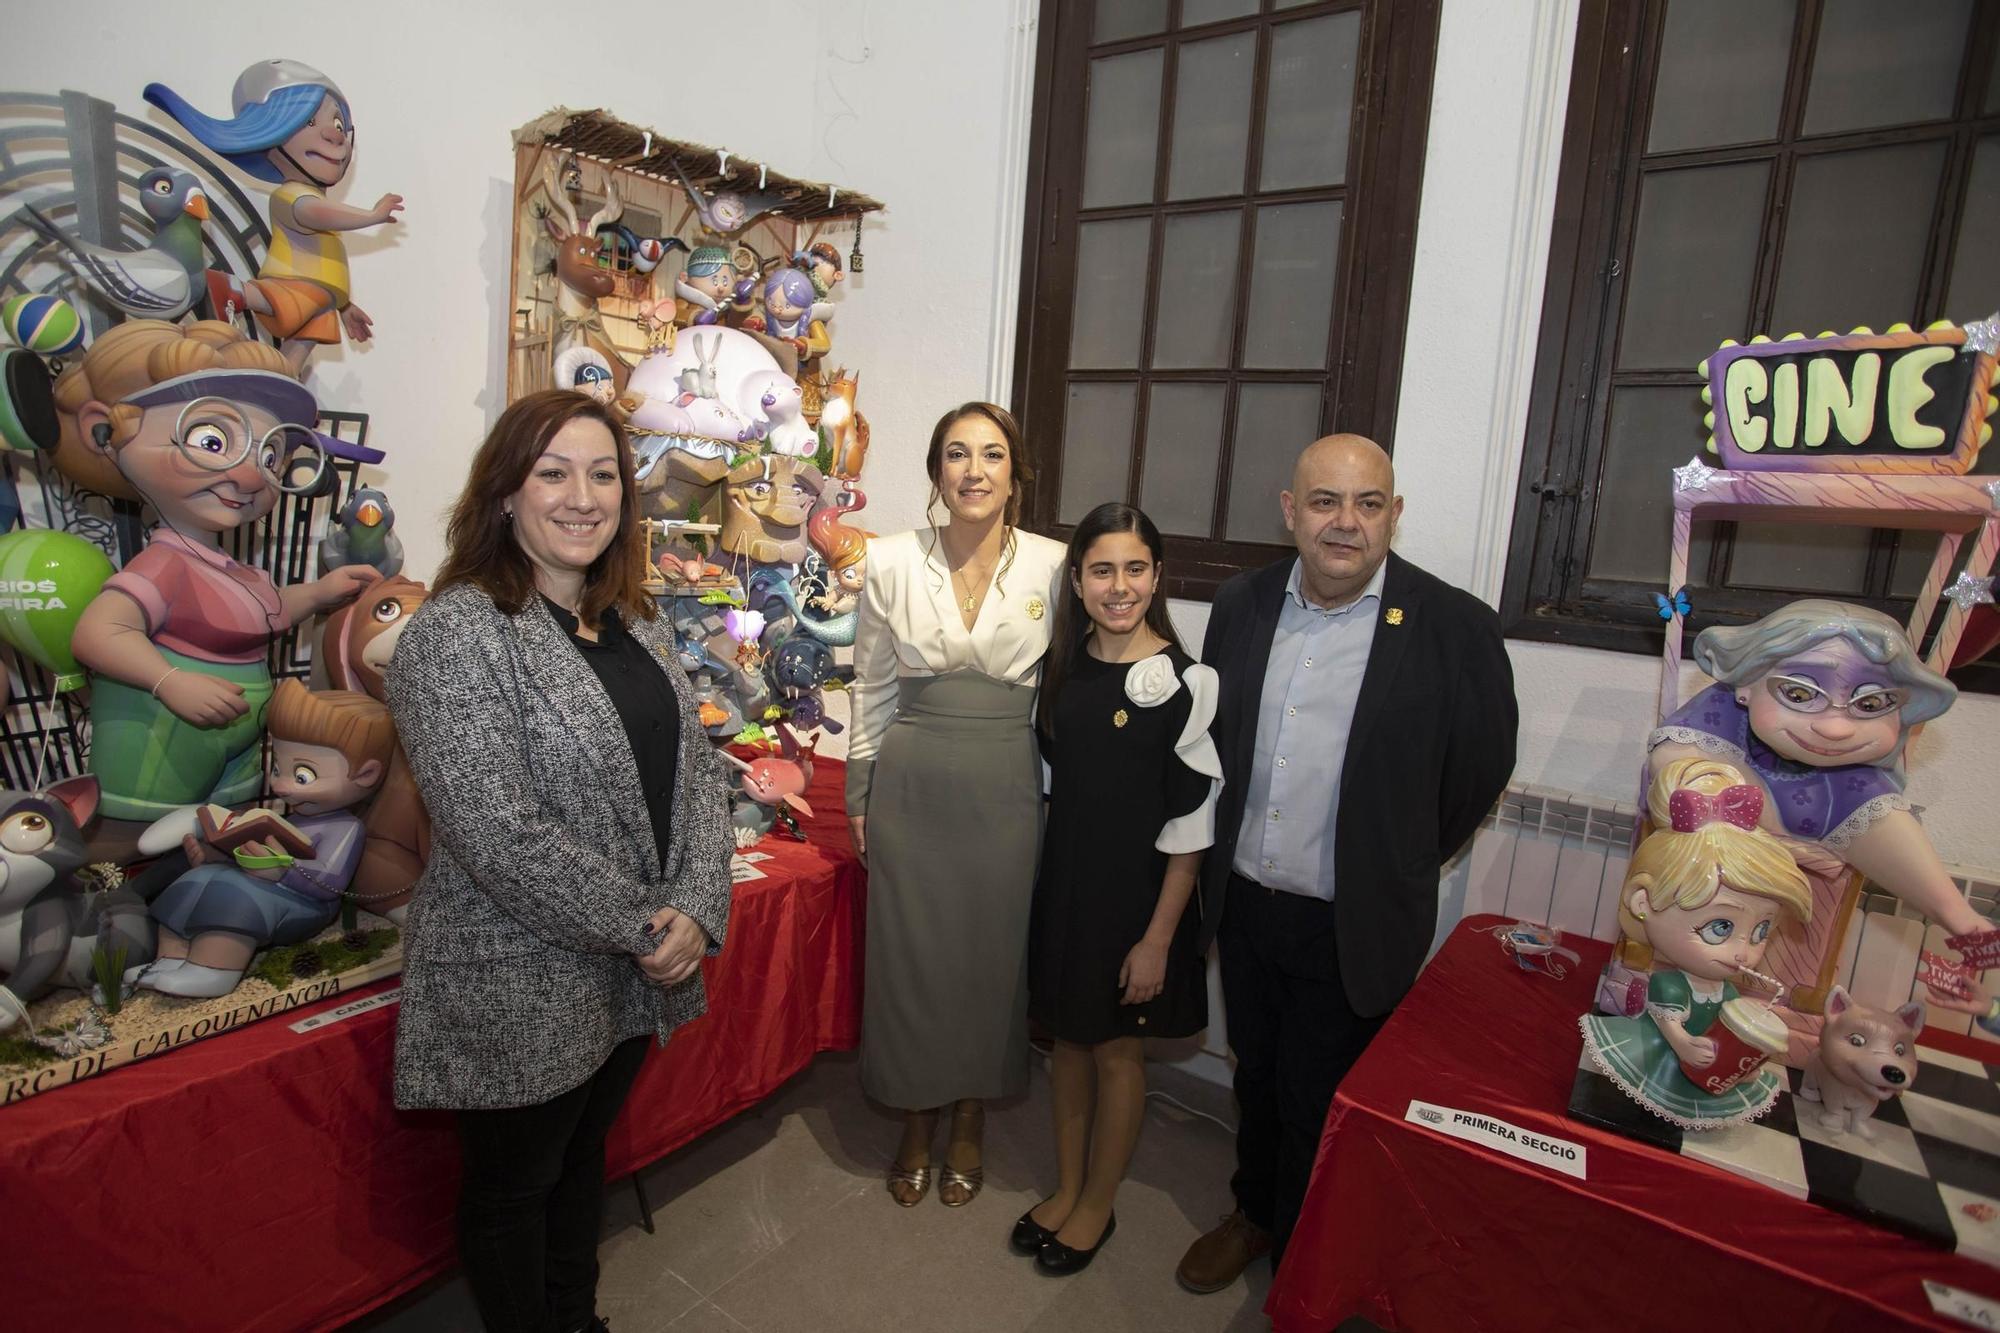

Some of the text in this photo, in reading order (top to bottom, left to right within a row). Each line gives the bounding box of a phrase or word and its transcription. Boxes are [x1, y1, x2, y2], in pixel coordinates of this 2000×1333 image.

[1725, 346, 1956, 453] CINE
[1453, 1113, 1576, 1161] PRIMERA SECCIÓ
